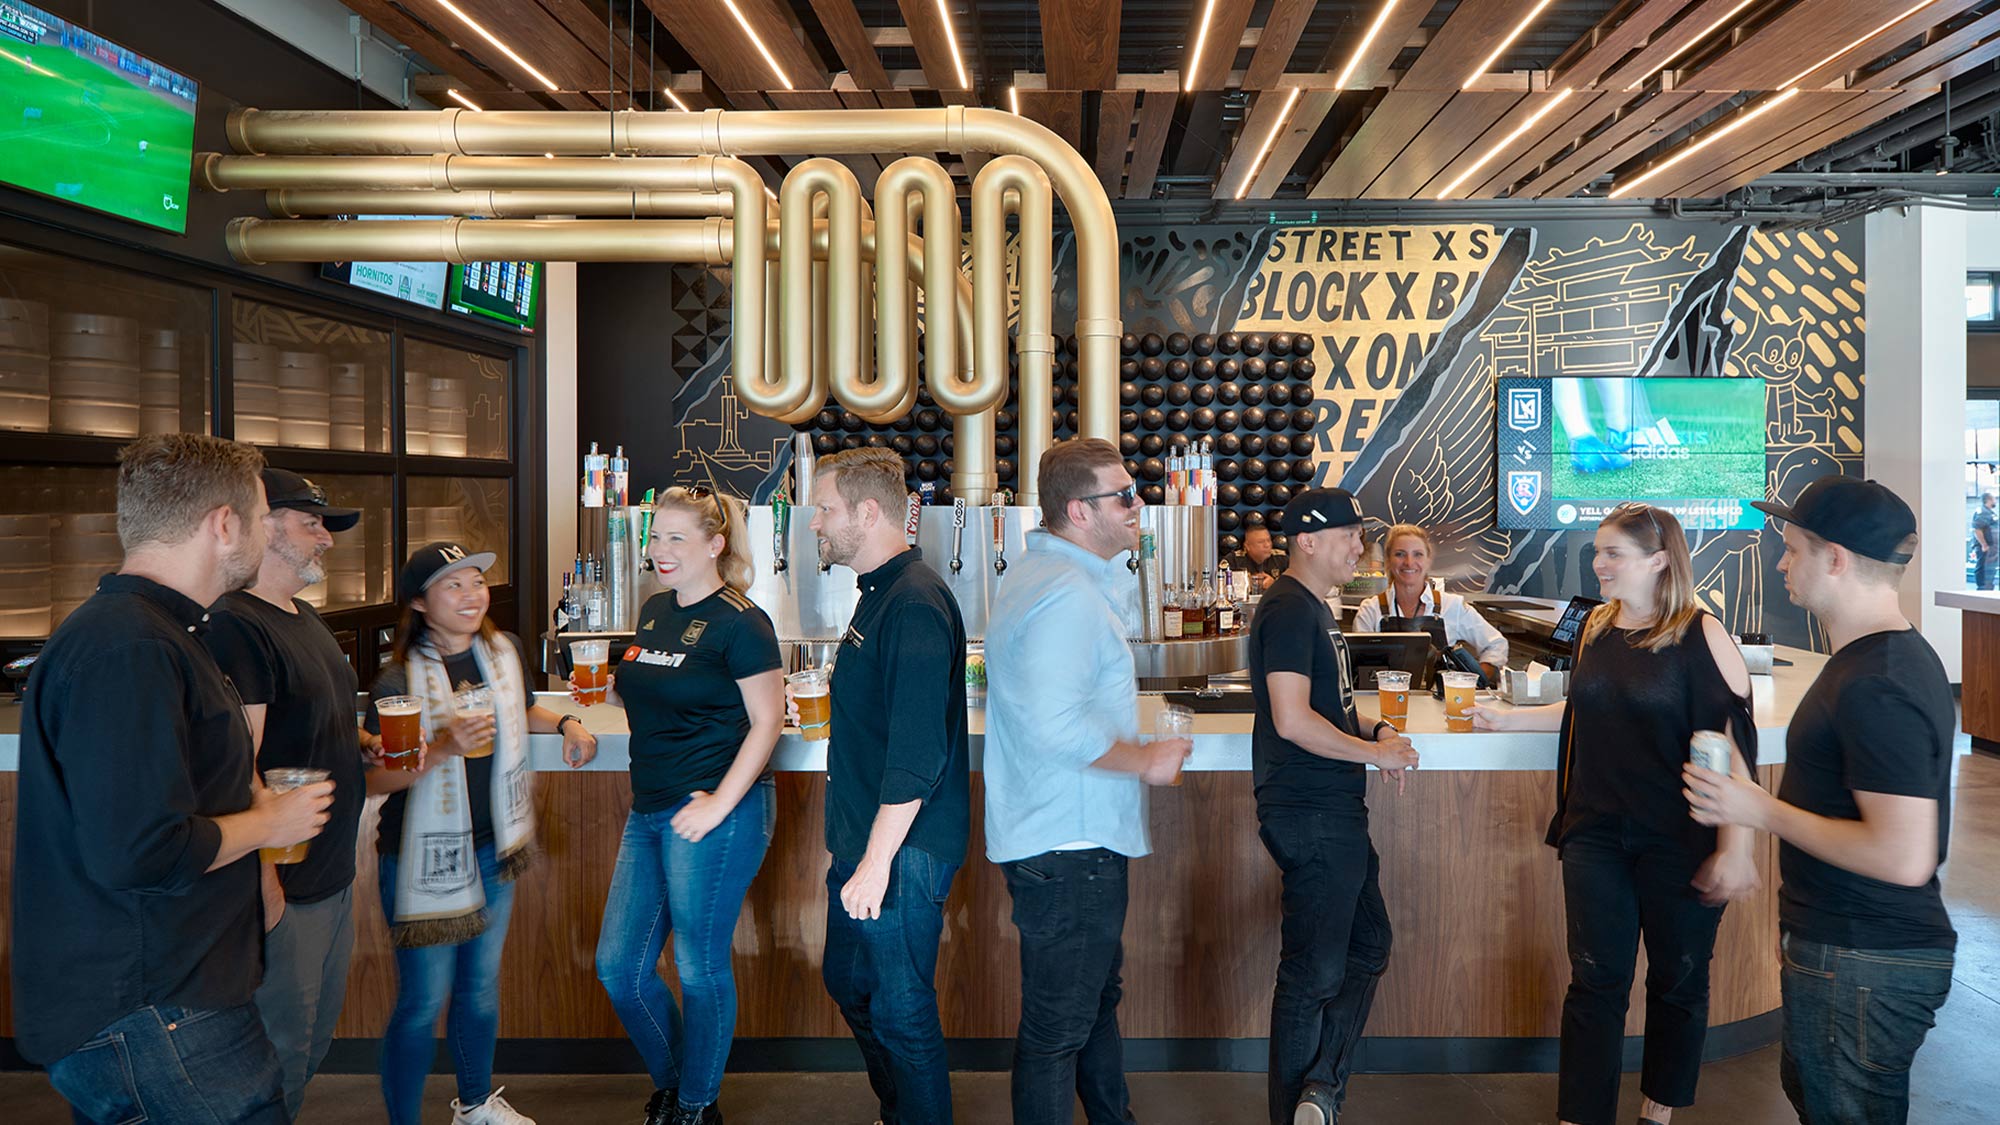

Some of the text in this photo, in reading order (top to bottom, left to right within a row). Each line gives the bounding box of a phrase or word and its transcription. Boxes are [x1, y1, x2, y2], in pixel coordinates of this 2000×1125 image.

[1267, 229, 1411, 263] STREET
[1432, 230, 1458, 261] X
[356, 264, 393, 286] HORNITOS
[1239, 270, 1378, 322] BLOCK
[1386, 271, 1420, 321] X
[1321, 335, 1361, 390] X
[1517, 445, 1532, 460] VS
[1625, 444, 1690, 460] adidas
[906, 496, 921, 536] Coors
[1580, 507, 1603, 516] YELL
